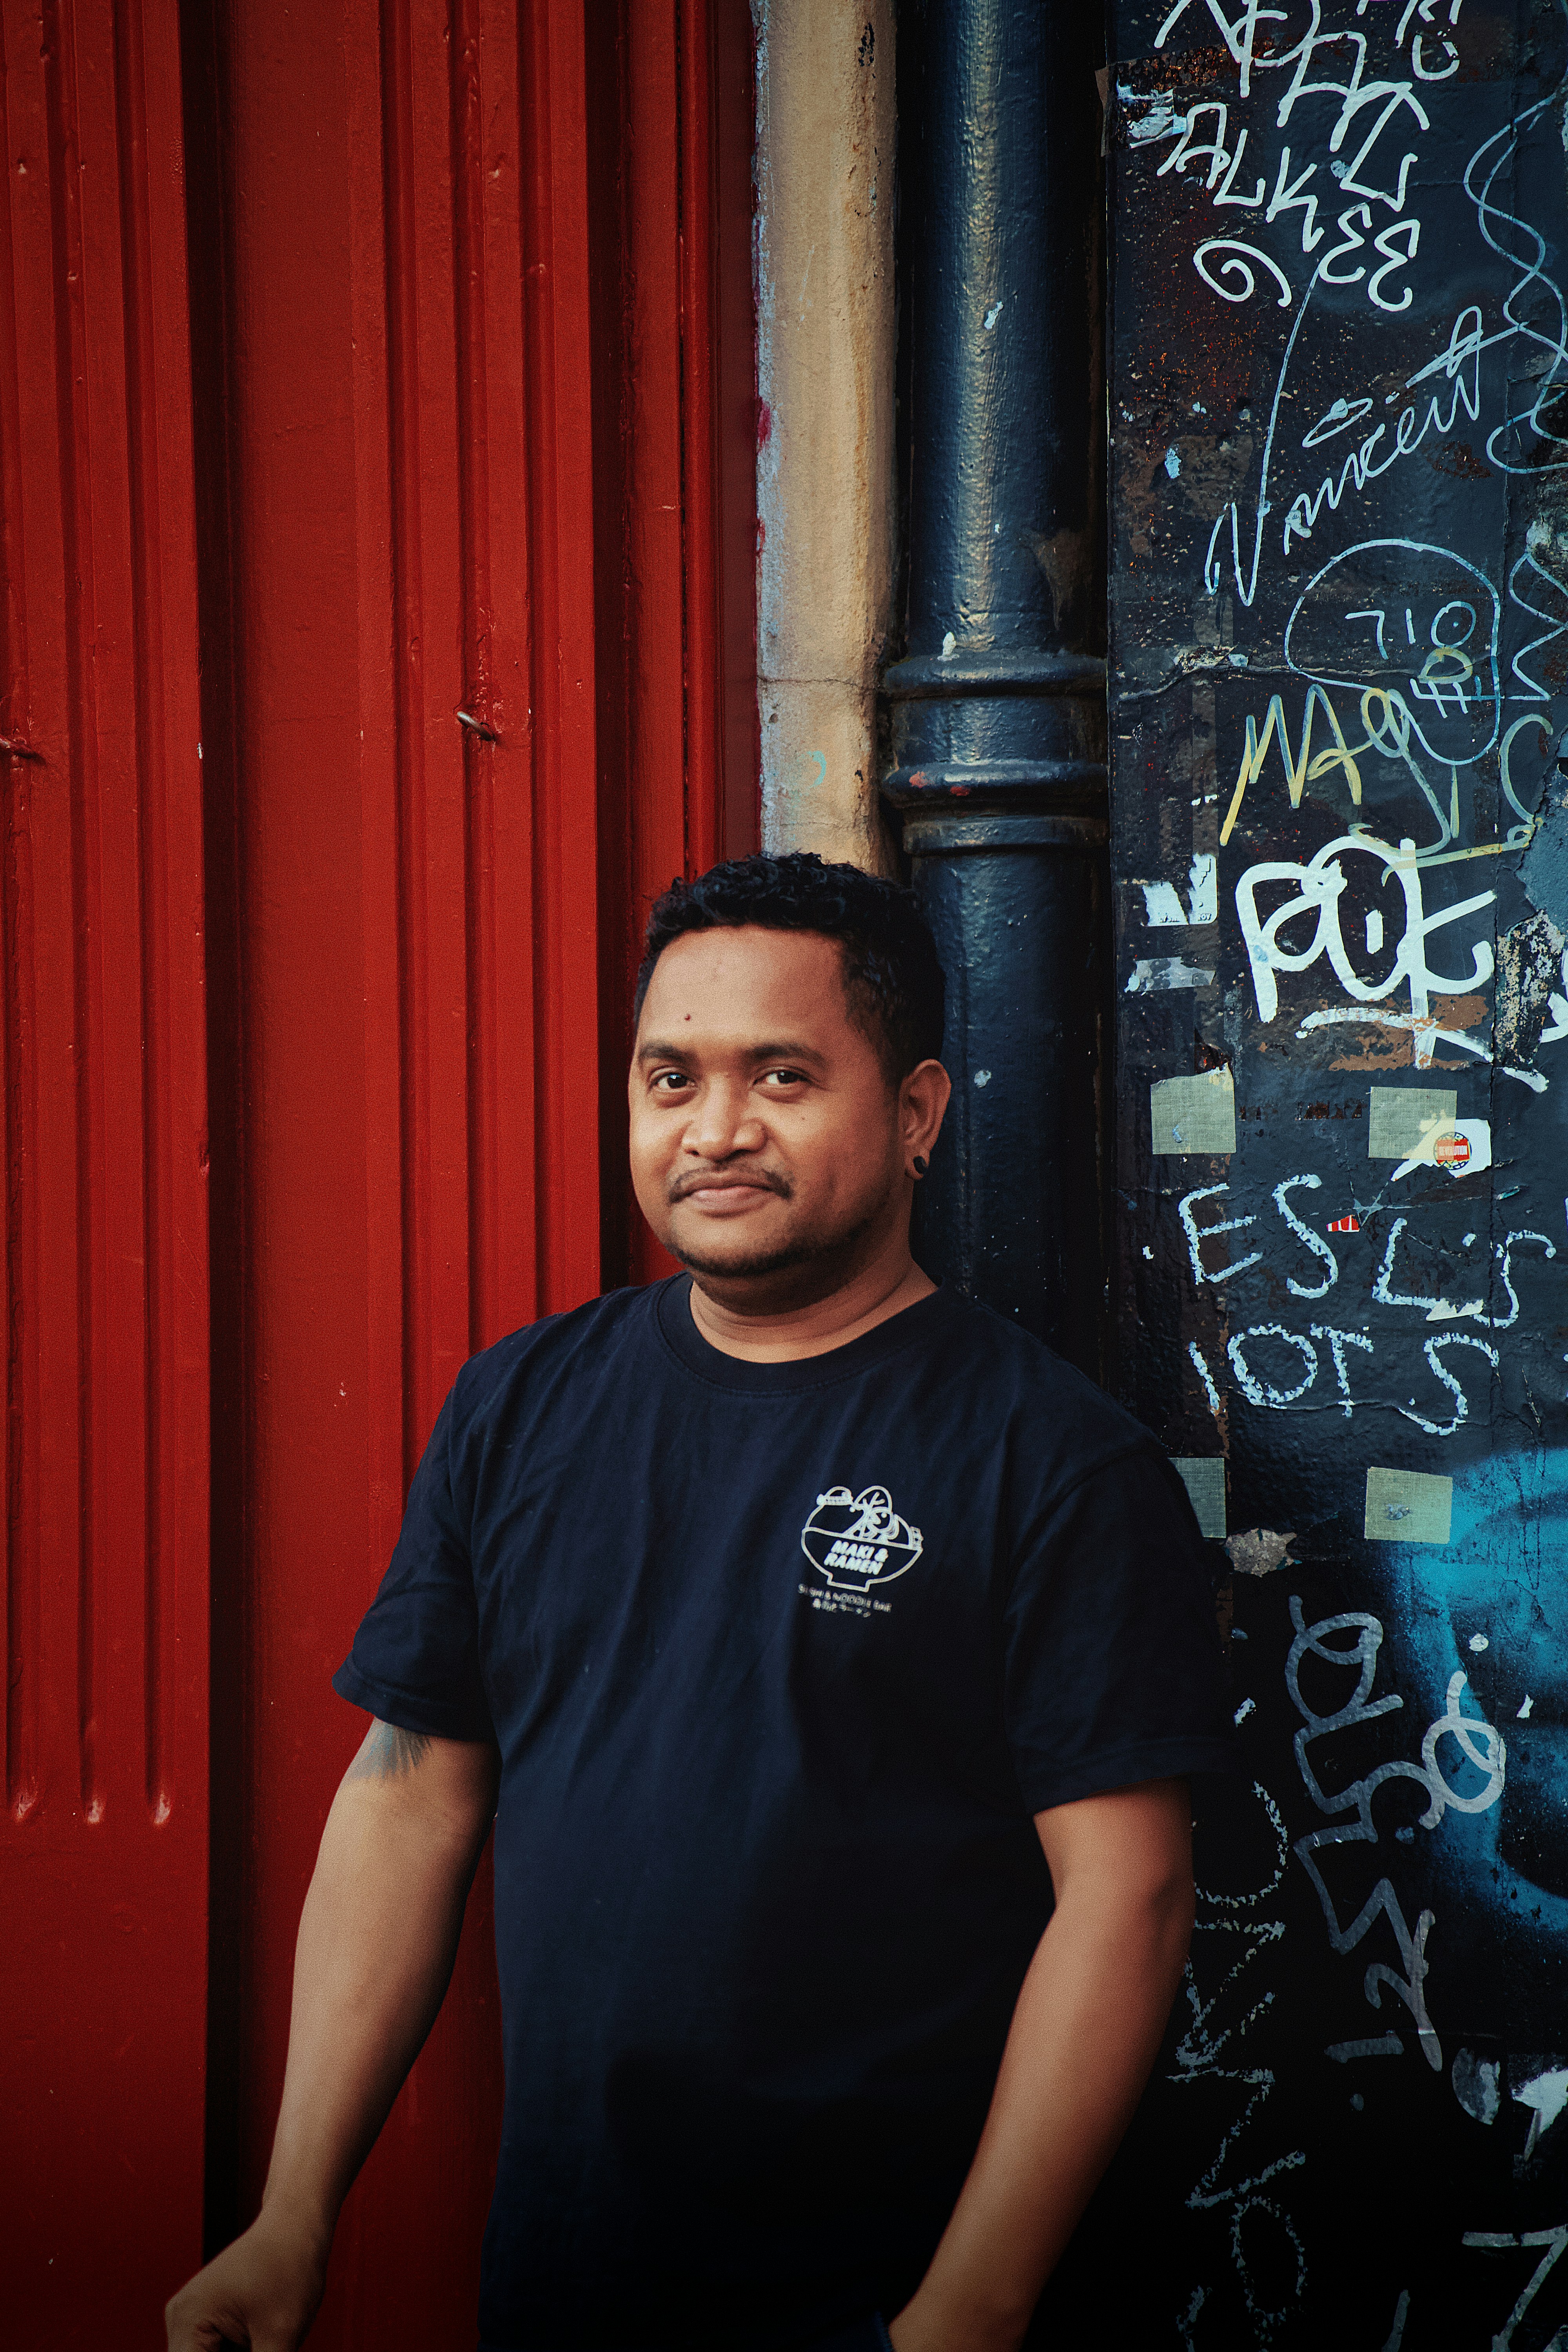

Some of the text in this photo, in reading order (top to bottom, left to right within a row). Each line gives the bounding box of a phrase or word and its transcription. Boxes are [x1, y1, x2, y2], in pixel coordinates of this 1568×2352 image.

[831, 1540, 889, 1563] MAKI &
[824, 1552, 884, 1575] RAMEN
